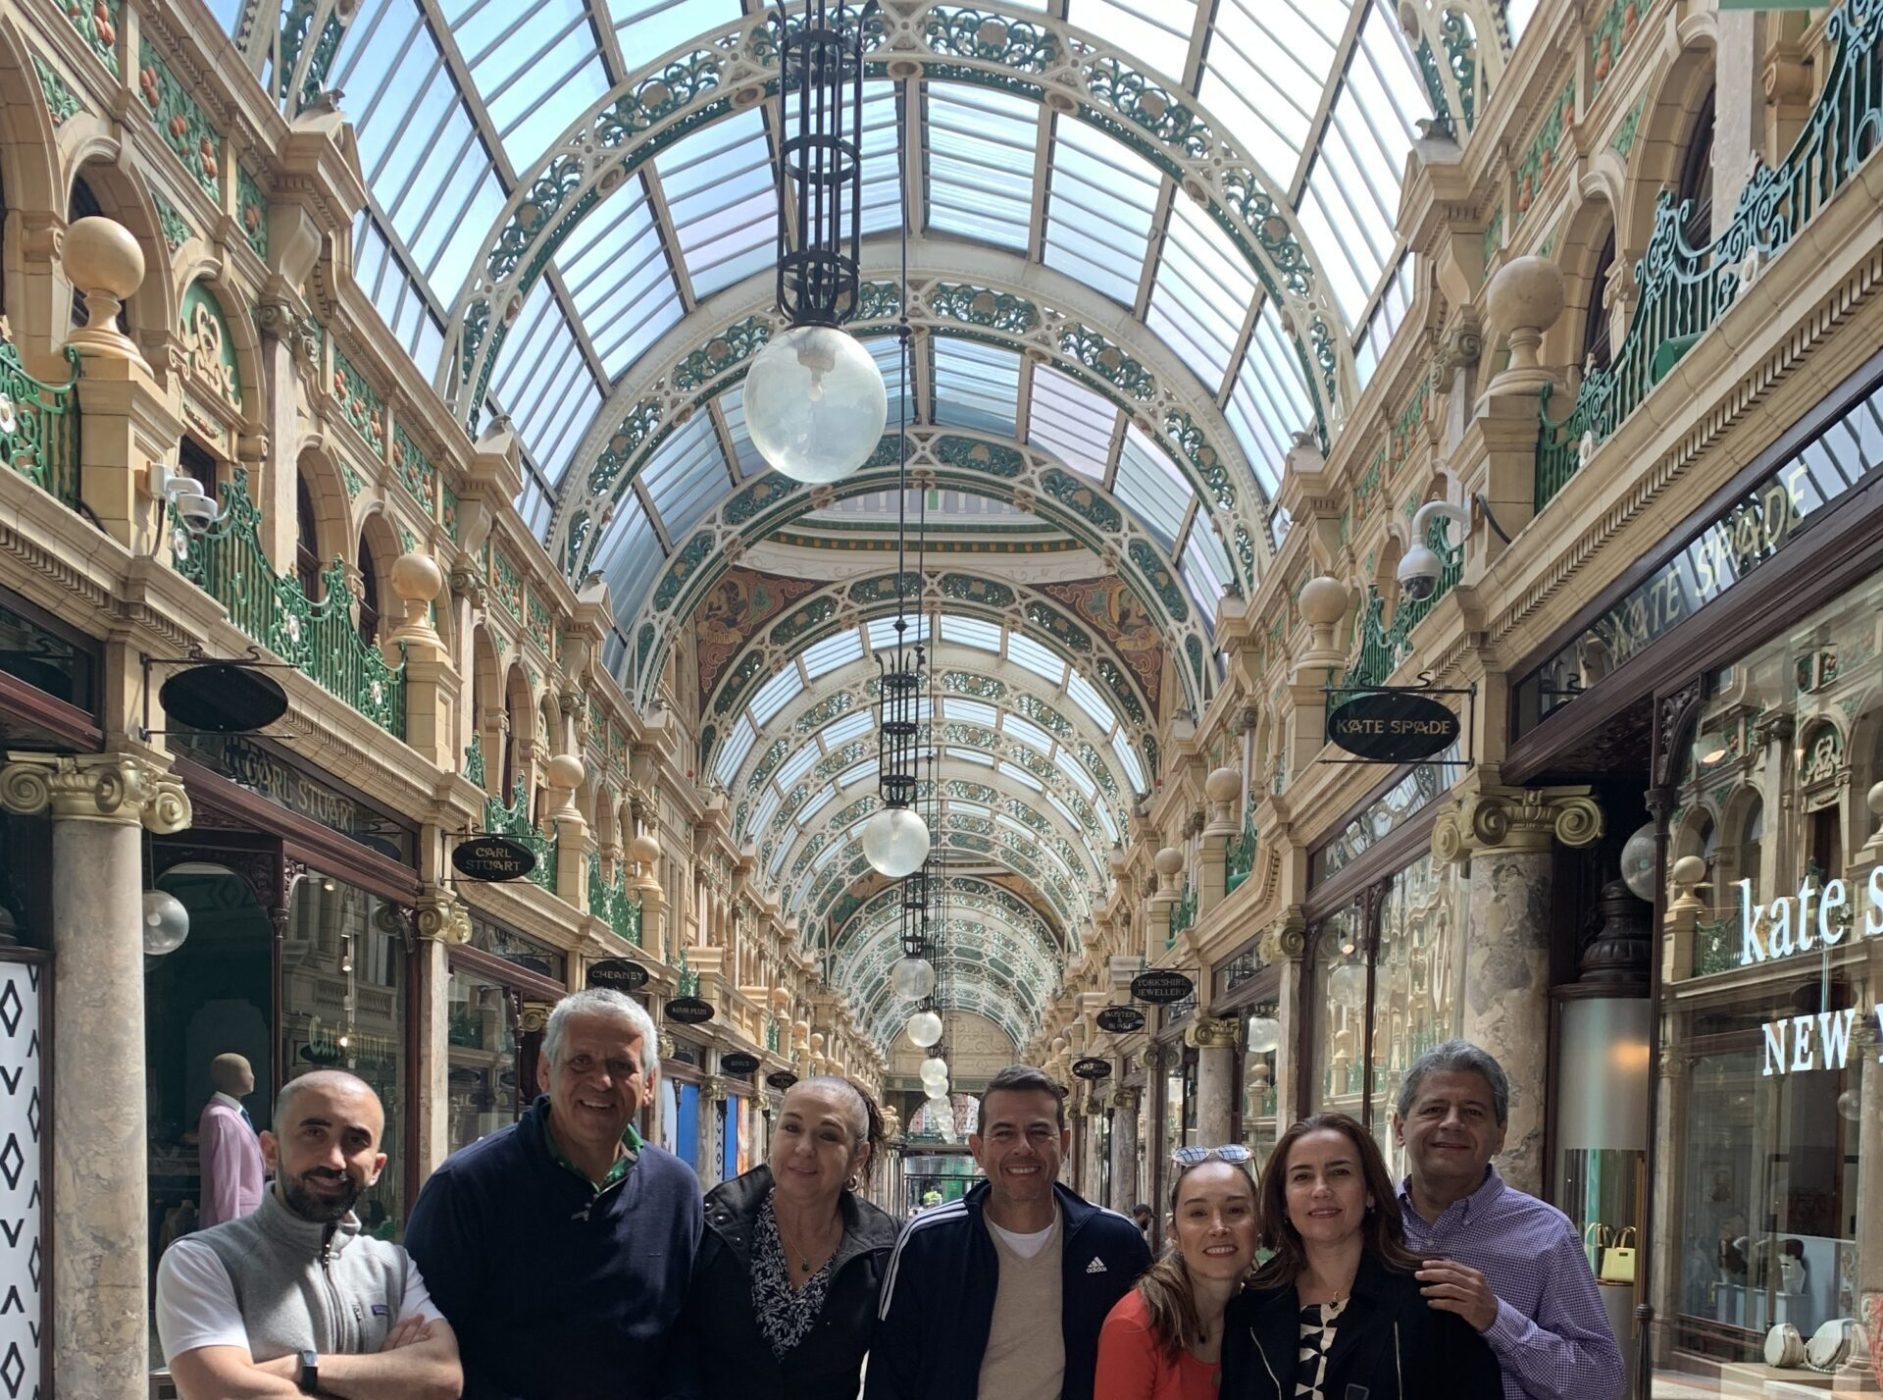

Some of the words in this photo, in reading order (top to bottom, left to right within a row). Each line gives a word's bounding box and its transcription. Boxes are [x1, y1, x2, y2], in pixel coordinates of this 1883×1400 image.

[1695, 463, 1808, 597] SPADE
[1336, 719, 1384, 734] KATE
[1390, 719, 1451, 735] SPADE
[245, 753, 293, 801] CARL
[298, 782, 357, 835] STUART
[475, 847, 512, 858] CARL
[465, 860, 521, 872] STUART
[1740, 875, 1846, 966] kate
[591, 969, 645, 981] CHEANEY
[1135, 978, 1187, 987] YORKSHIRE
[1136, 988, 1187, 997] JEWELLERY
[1762, 1007, 1856, 1077] NEW
